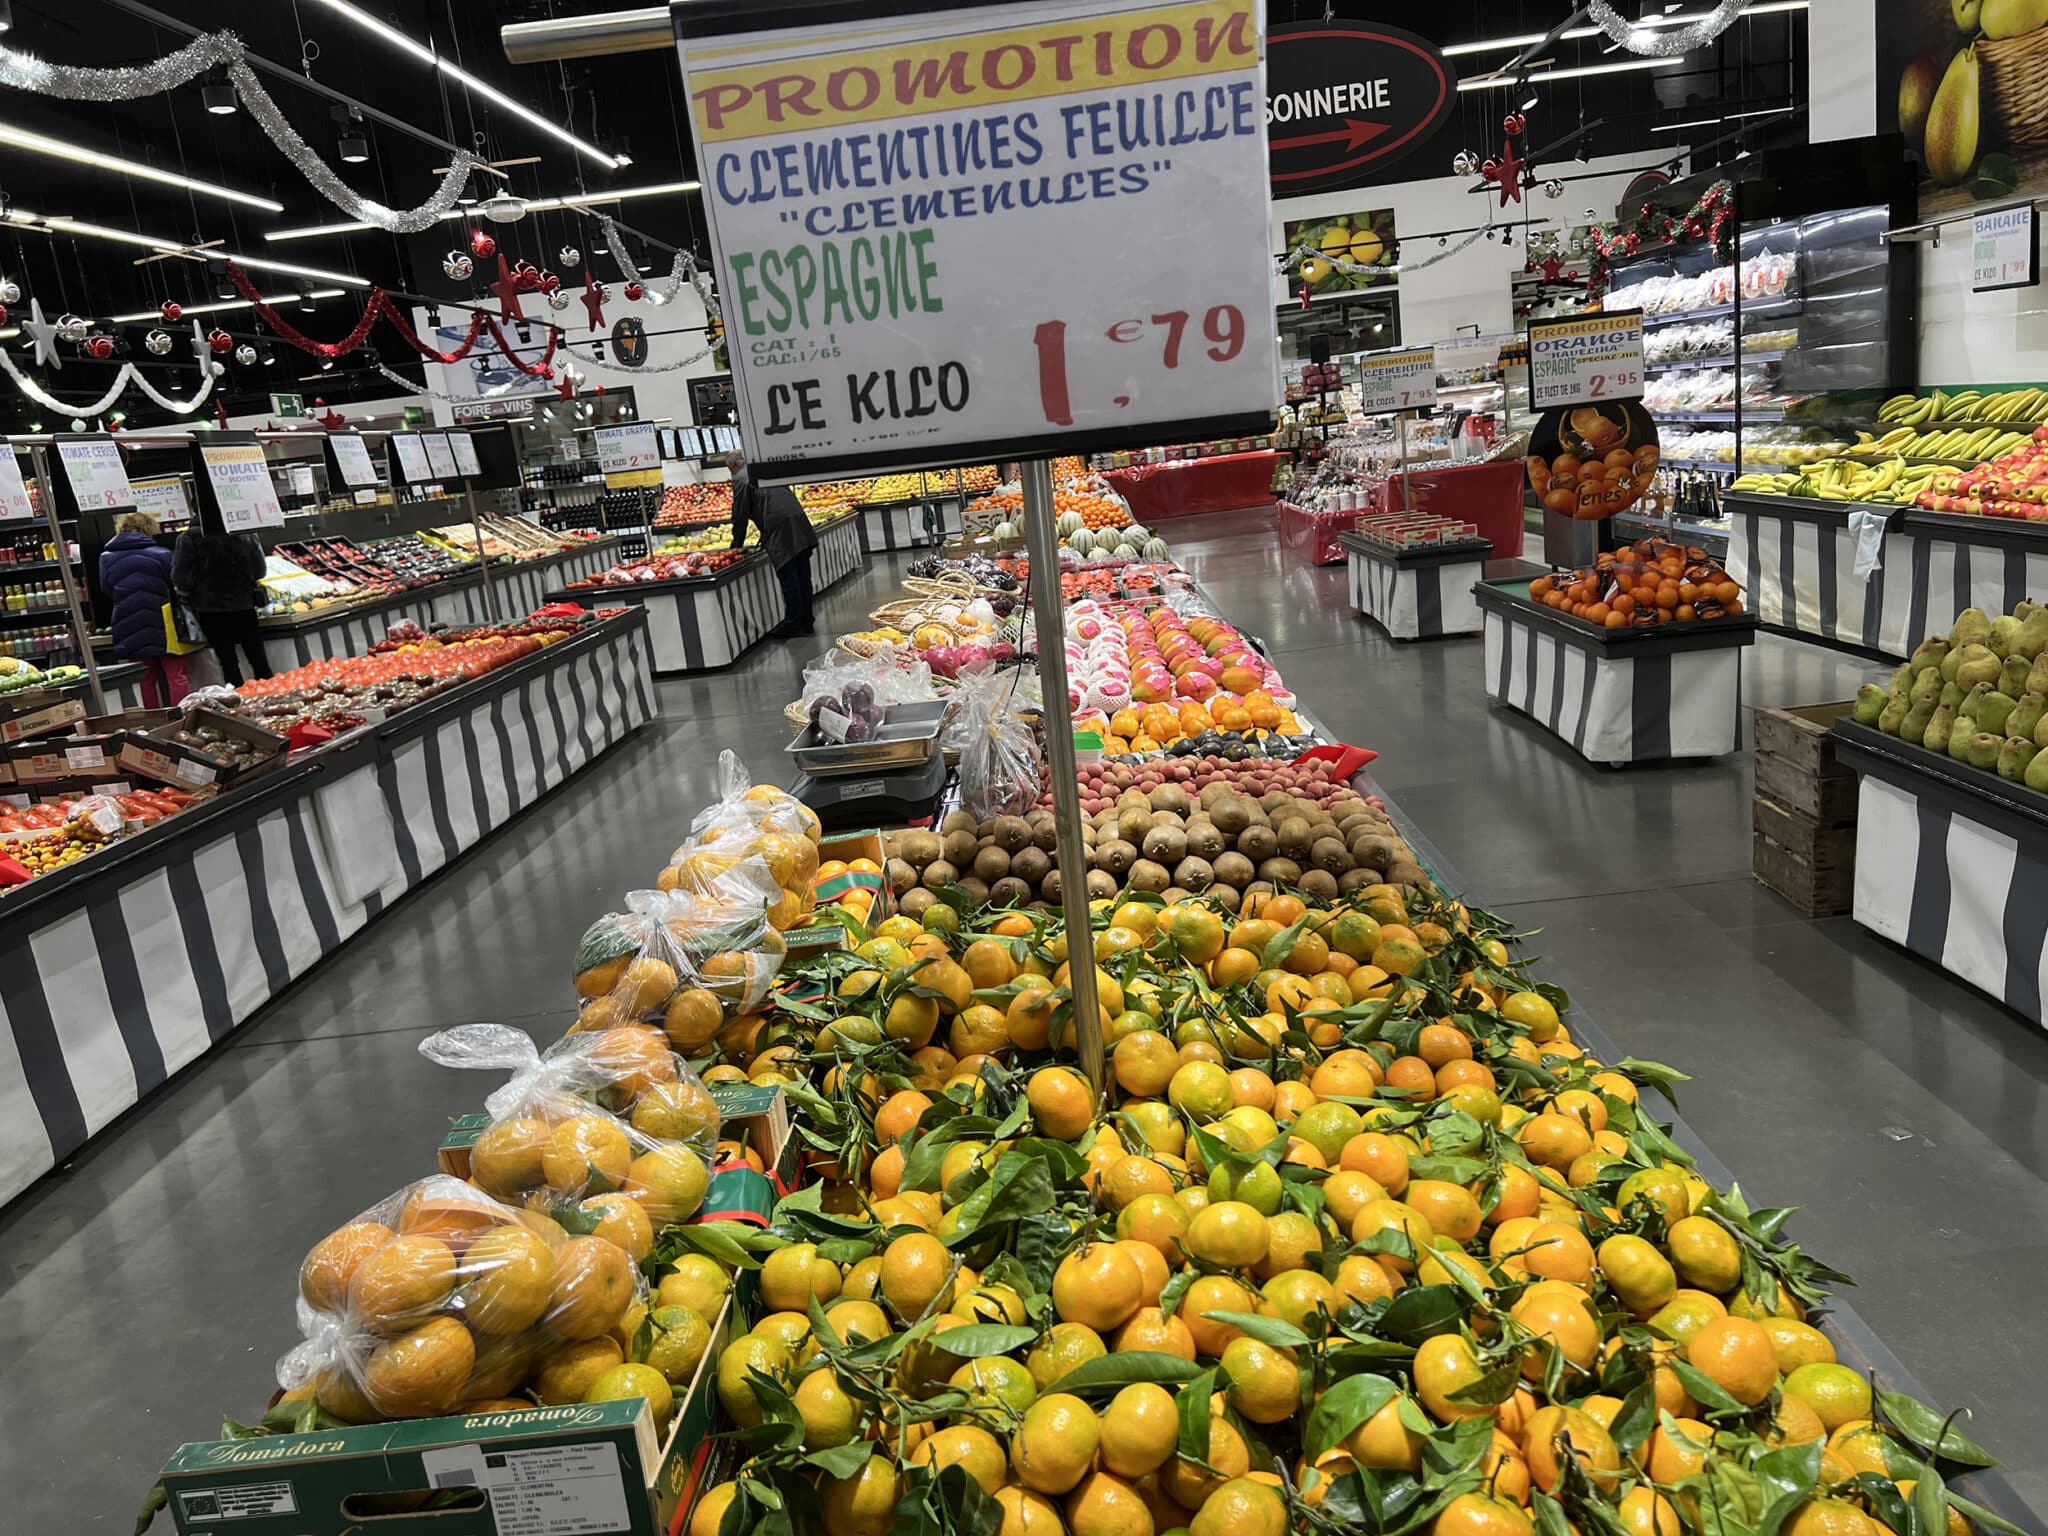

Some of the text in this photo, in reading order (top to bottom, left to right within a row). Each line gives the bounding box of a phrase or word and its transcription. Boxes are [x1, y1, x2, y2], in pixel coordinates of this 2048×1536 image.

[692, 12, 1256, 130] PROMOTION
[716, 82, 1256, 206] CLEMENTINES FEUILLE
[1975, 211, 2029, 233] BANANE
[730, 228, 944, 336] ESPAGNE
[1533, 317, 1641, 339] PROMOTION
[1535, 330, 1639, 352] ORANGE
[1363, 354, 1433, 368] PROMOTION
[1364, 362, 1433, 377] CLEMENTINE
[1534, 351, 1639, 378] ESPAGNE SPECIAL JUS
[764, 379, 826, 435] LE
[847, 360, 969, 424] KILO
[454, 404, 491, 418] FOIRE
[503, 400, 533, 412] VINS
[209, 462, 267, 477] TOMATE
